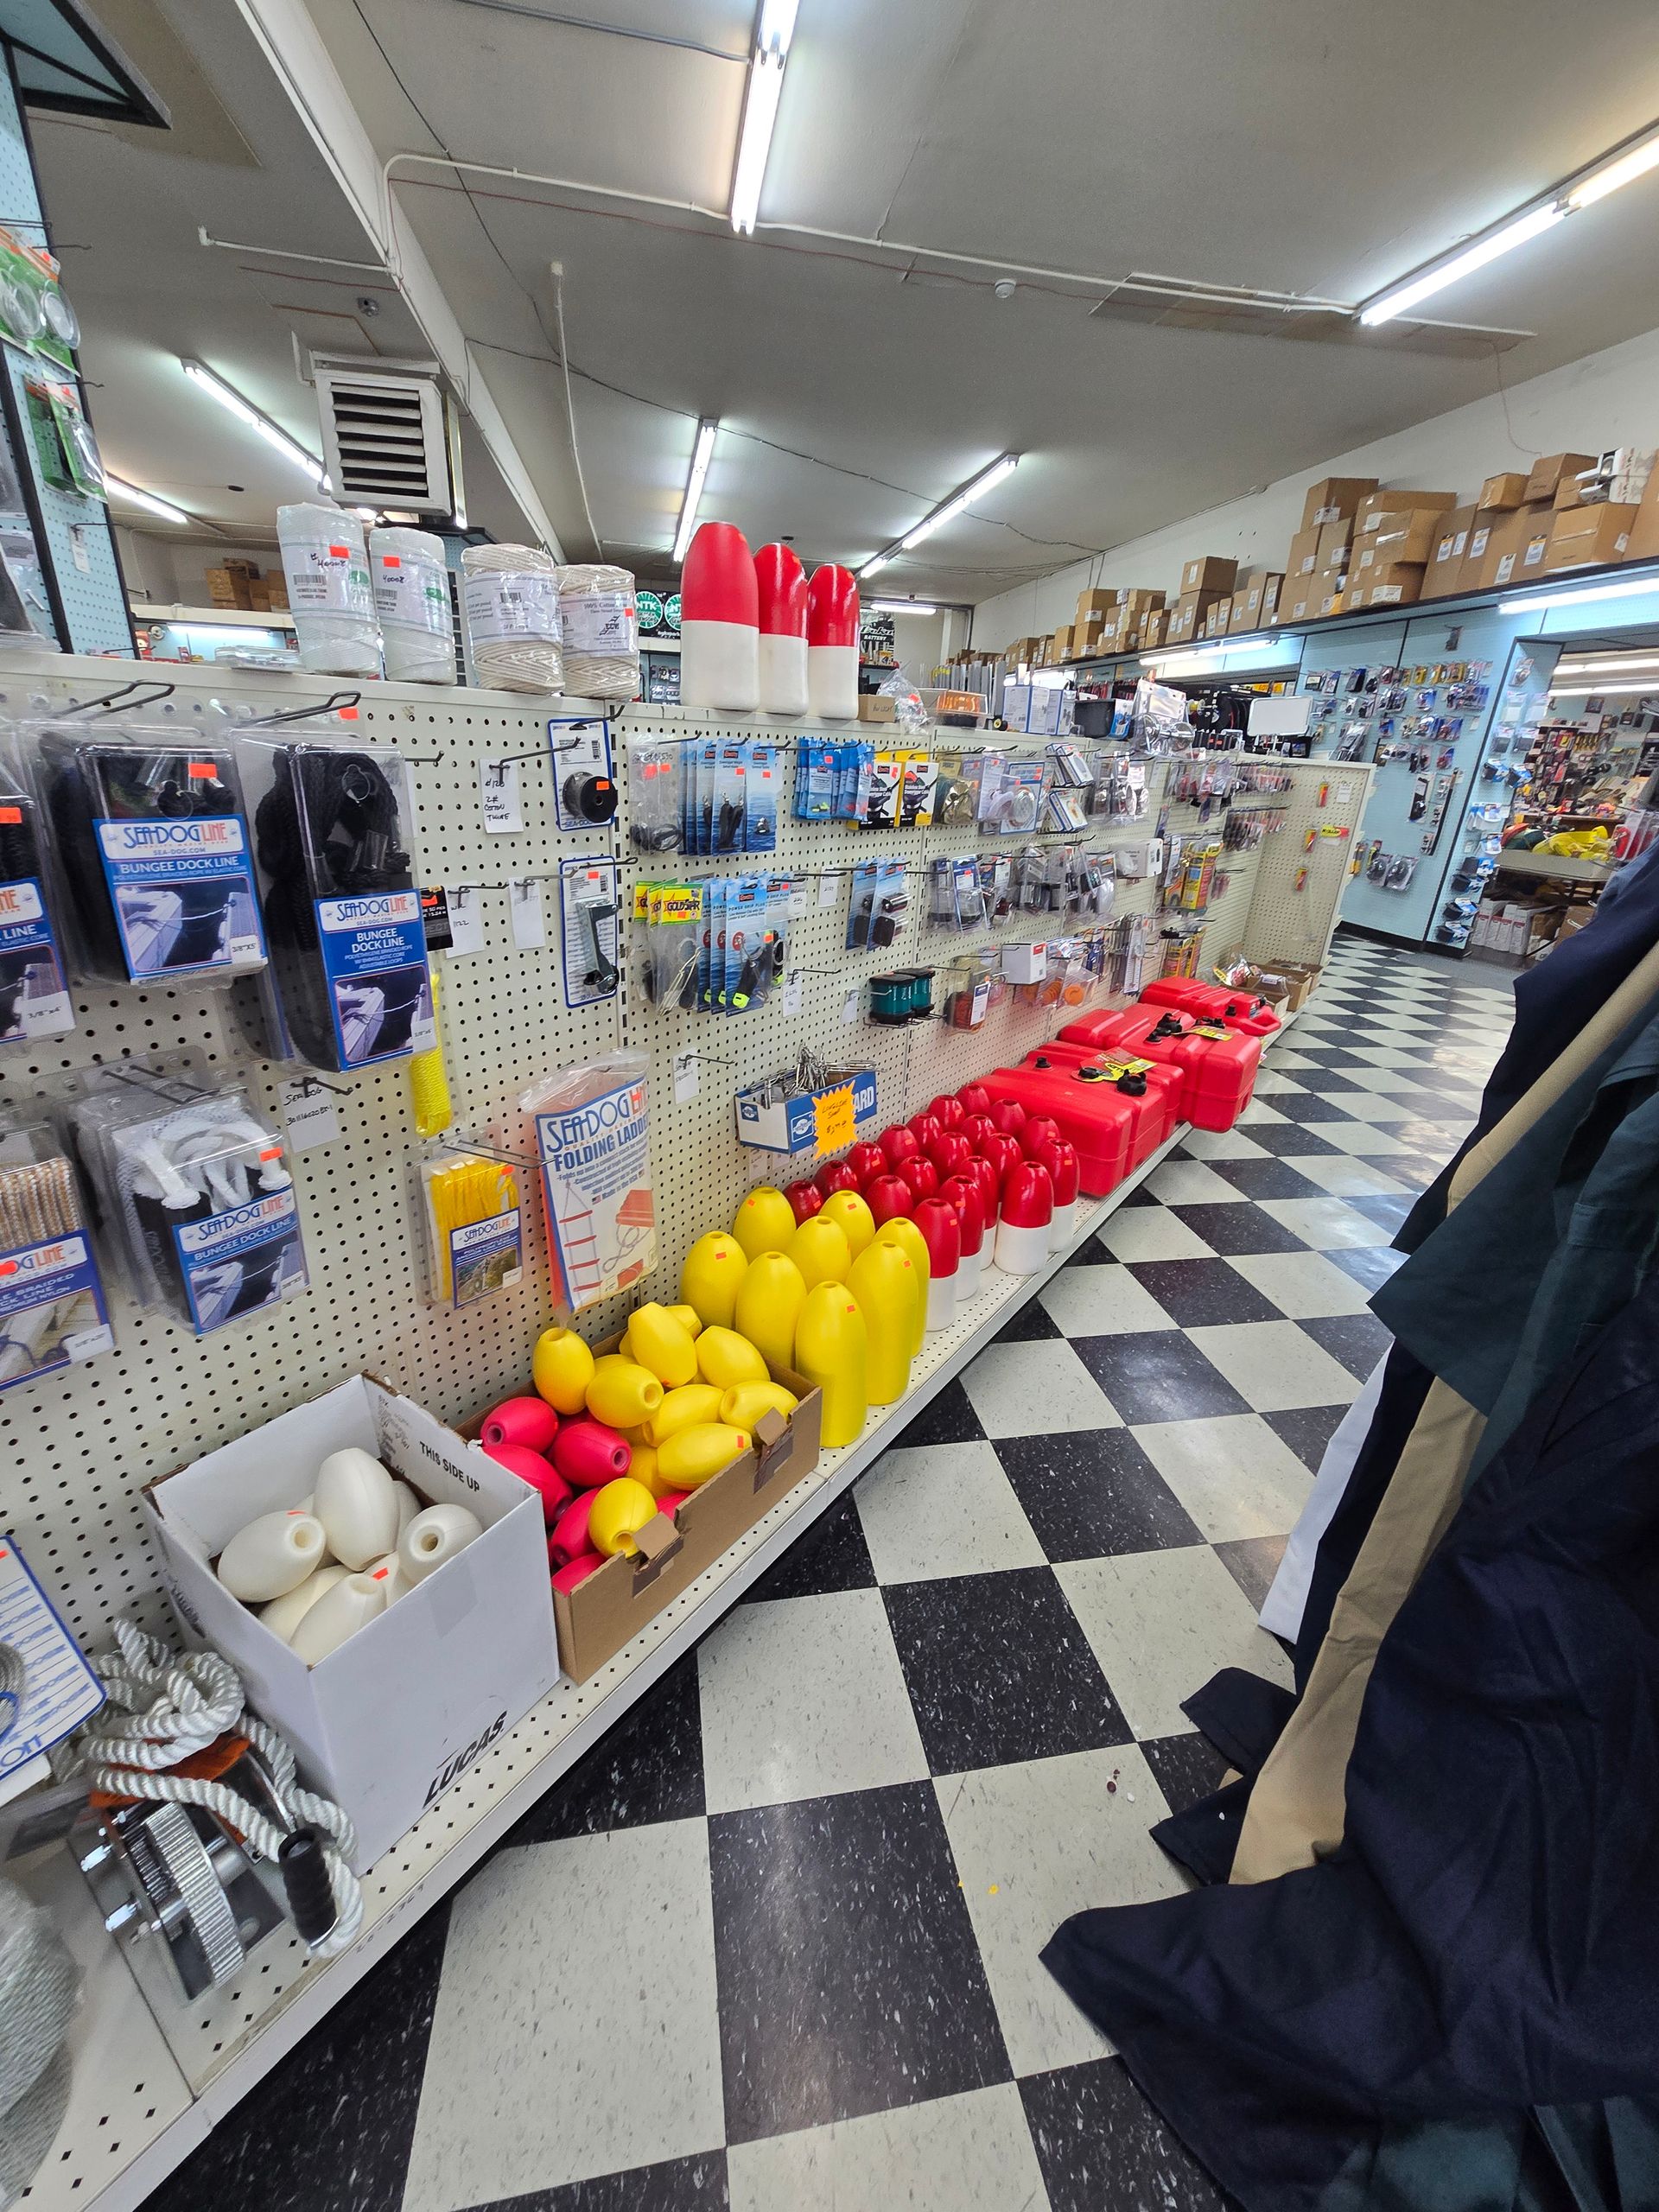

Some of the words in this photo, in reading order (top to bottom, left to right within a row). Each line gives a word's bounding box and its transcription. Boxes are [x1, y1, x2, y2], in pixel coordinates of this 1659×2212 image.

[123, 824, 200, 849] SEA-DOG
[200, 823, 228, 842] LINE
[152, 848, 207, 856] SEA-DOG.COM
[120, 861, 175, 874] BUNGEE
[176, 859, 214, 871] DOCK
[215, 856, 240, 867] LINE
[337, 899, 390, 922] SEA-DOG
[389, 895, 409, 912] LINE
[3, 924, 37, 940] LINE
[356, 927, 397, 943] BUNGEE
[352, 938, 383, 953] DOCK
[384, 937, 405, 948] LINE
[546, 1092, 630, 1154] SEA-DOG
[564, 1132, 604, 1151] QUALITY
[554, 1134, 616, 1173] FOLDING
[198, 1205, 260, 1242] SEA-DOG
[259, 1195, 285, 1216] LINE
[194, 1240, 239, 1262] BUNGEE
[240, 1228, 272, 1244] DOCK
[271, 1217, 293, 1232] LINE
[463, 1221, 499, 1243] SEA-DOG
[33, 1245, 66, 1267] LINE
[16, 1273, 75, 1295] BRAIDED
[24, 1286, 55, 1300] LINE
[419, 1440, 442, 1466] THIS
[442, 1458, 465, 1483] SIDE
[467, 1475, 480, 1492] UP
